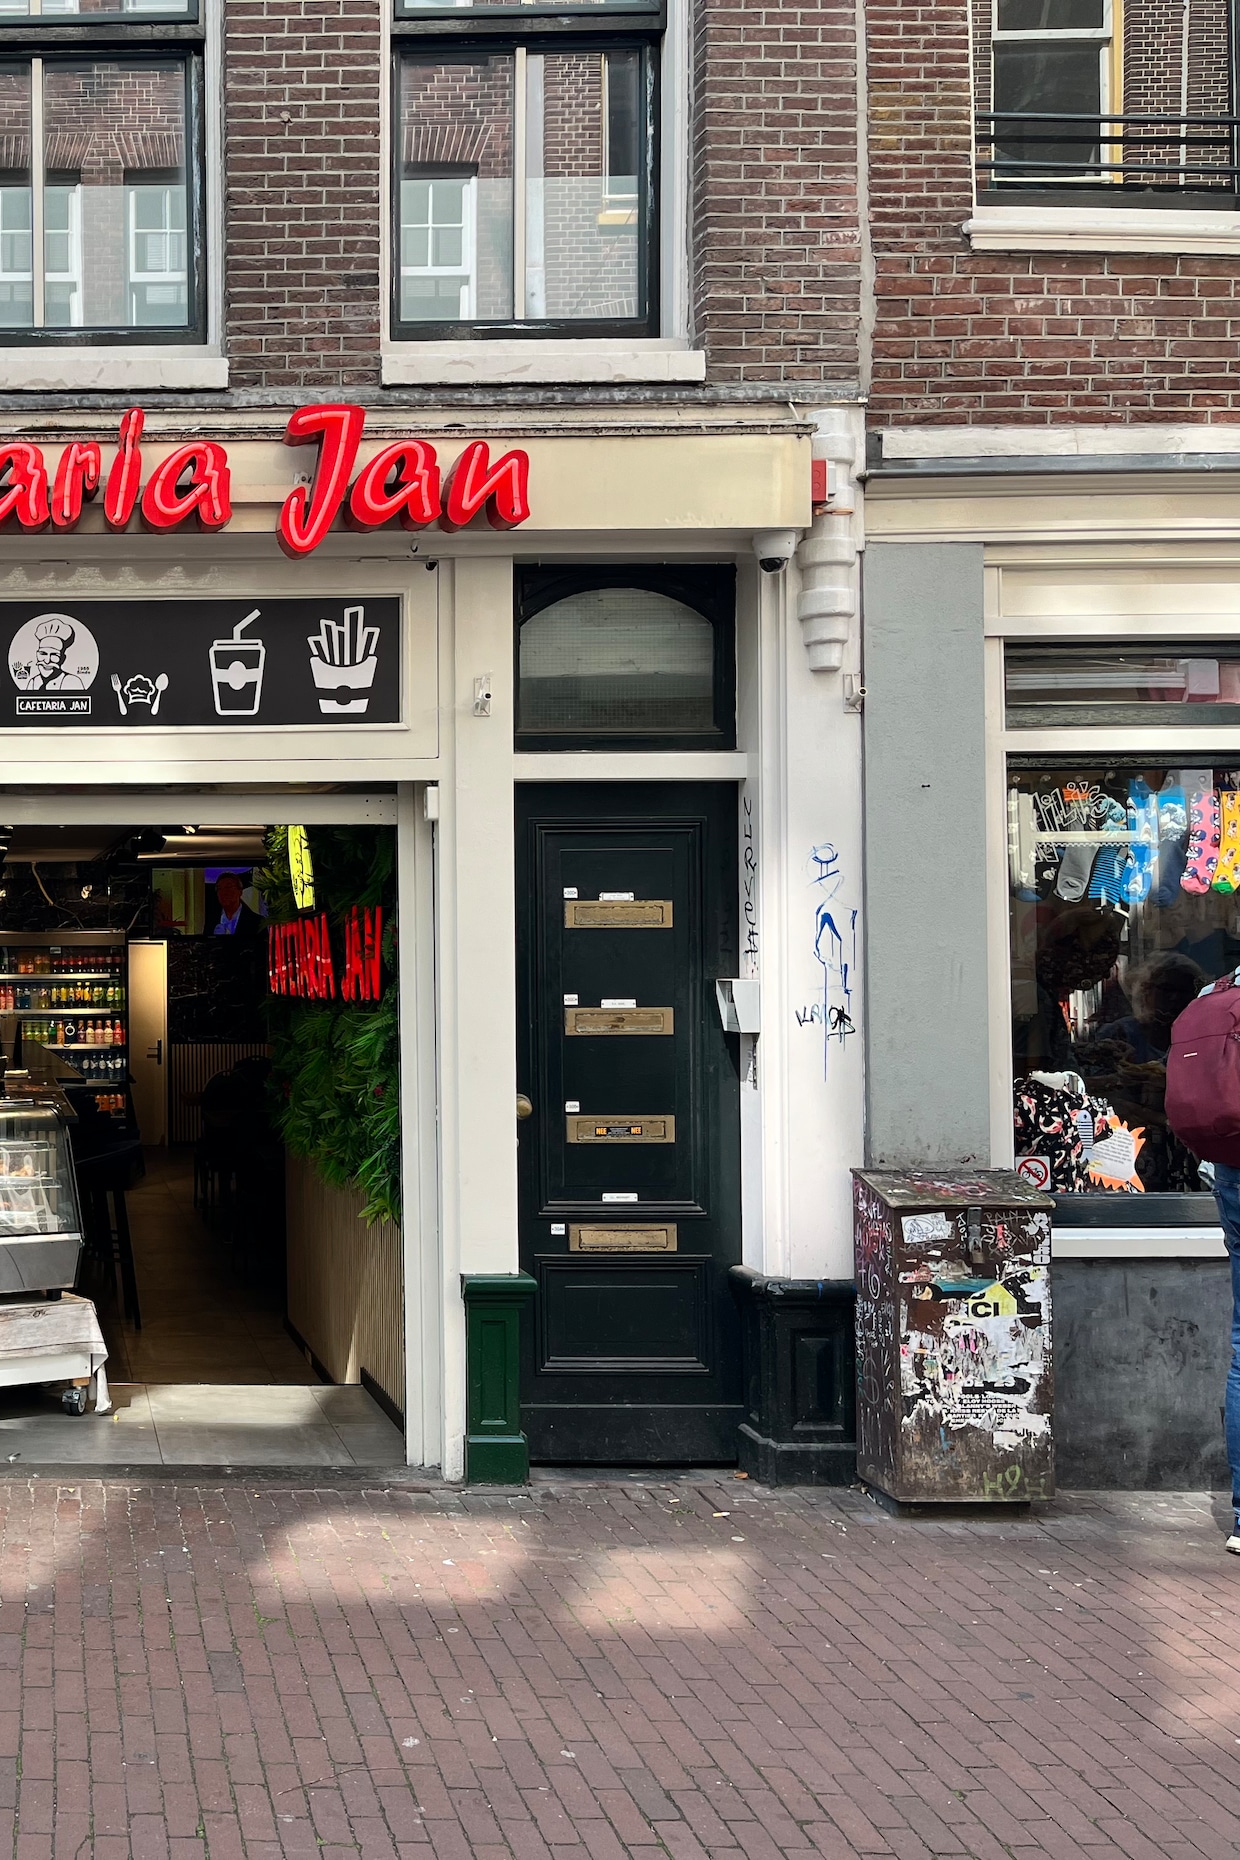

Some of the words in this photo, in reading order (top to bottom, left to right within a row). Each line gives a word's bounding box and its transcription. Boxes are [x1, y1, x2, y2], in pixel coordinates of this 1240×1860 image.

[276, 404, 531, 561] Jan
[19, 701, 67, 711] CAFETARIA
[70, 701, 88, 711] JAN
[631, 1127, 642, 1135] NEE
